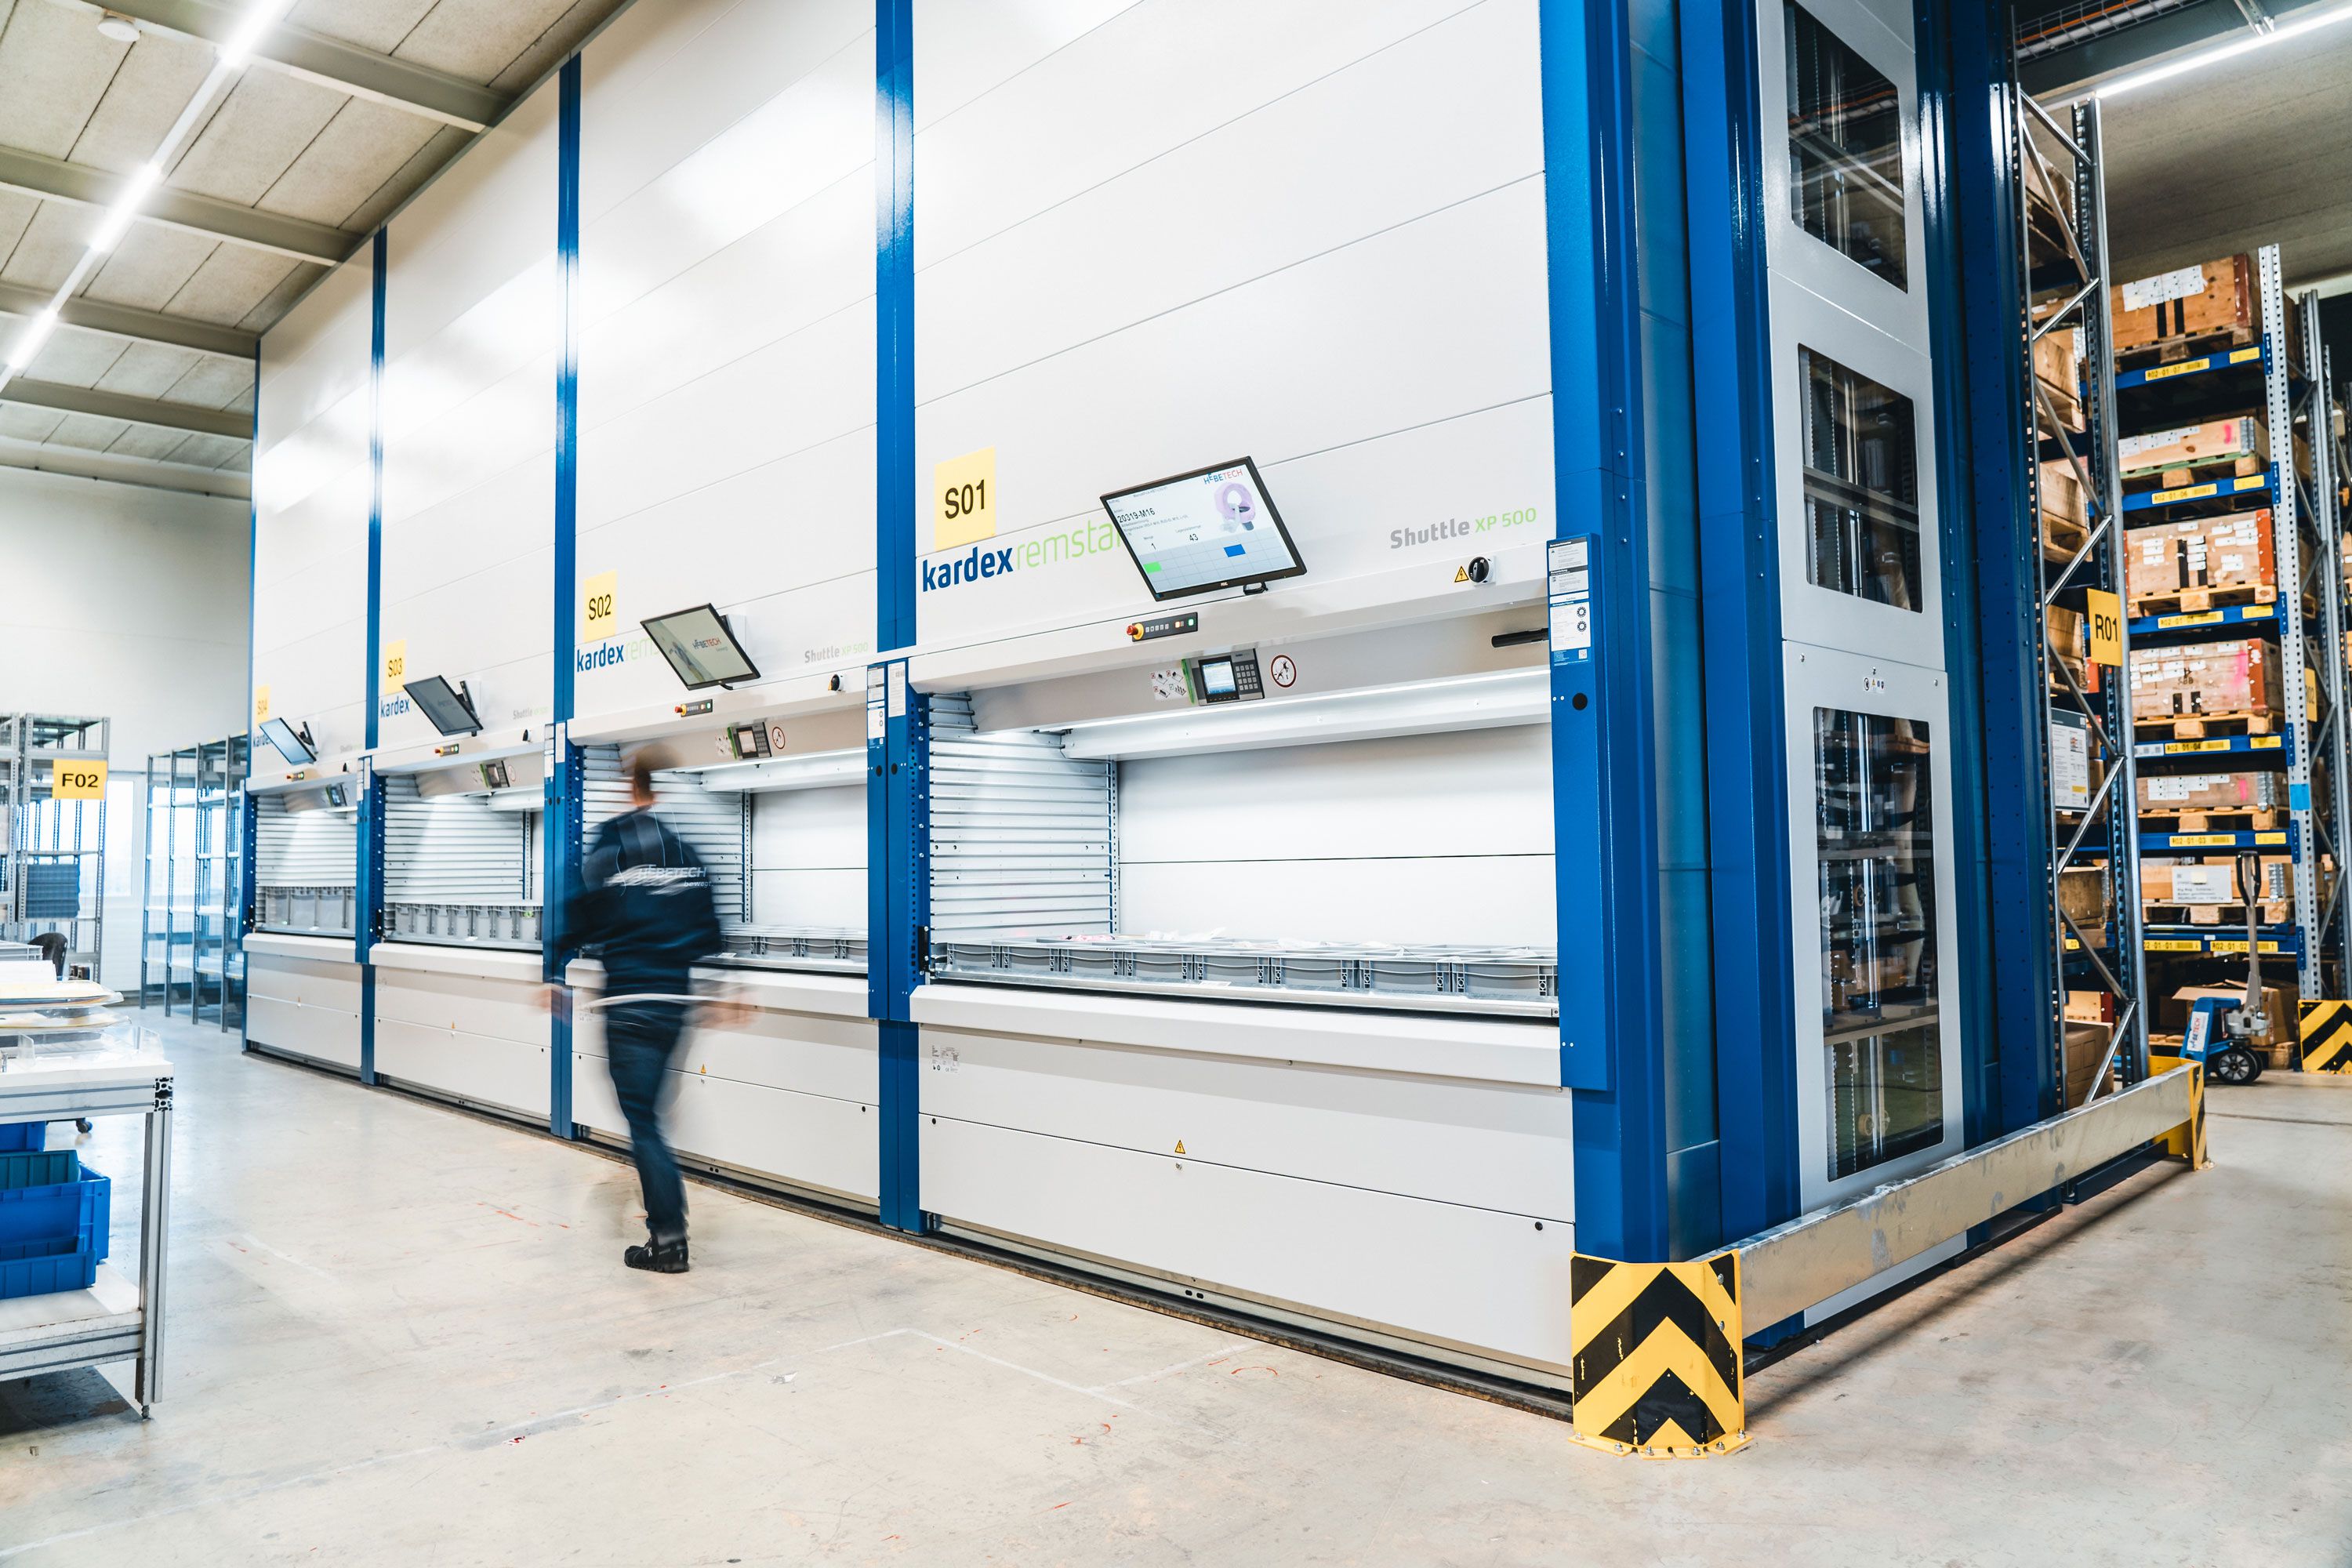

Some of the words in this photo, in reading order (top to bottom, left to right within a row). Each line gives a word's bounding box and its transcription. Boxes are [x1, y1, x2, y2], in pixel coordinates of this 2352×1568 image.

[1203, 468, 1243, 485] HEBETECH
[945, 479, 985, 520] S01
[1116, 507, 1156, 523] 20319-M16
[1189, 533, 1199, 542] 43
[1390, 517, 1470, 550] Shuttle
[1475, 515, 1497, 533] XP
[1501, 507, 1537, 528] 500
[922, 546, 1014, 592] kardex
[589, 593, 612, 621] S02
[2095, 614, 2118, 642] R01
[577, 642, 624, 672] kardex
[804, 645, 840, 664] Shuttle
[387, 658, 402, 677] S03
[380, 695, 410, 718] kardex
[62, 773, 99, 788] F02
